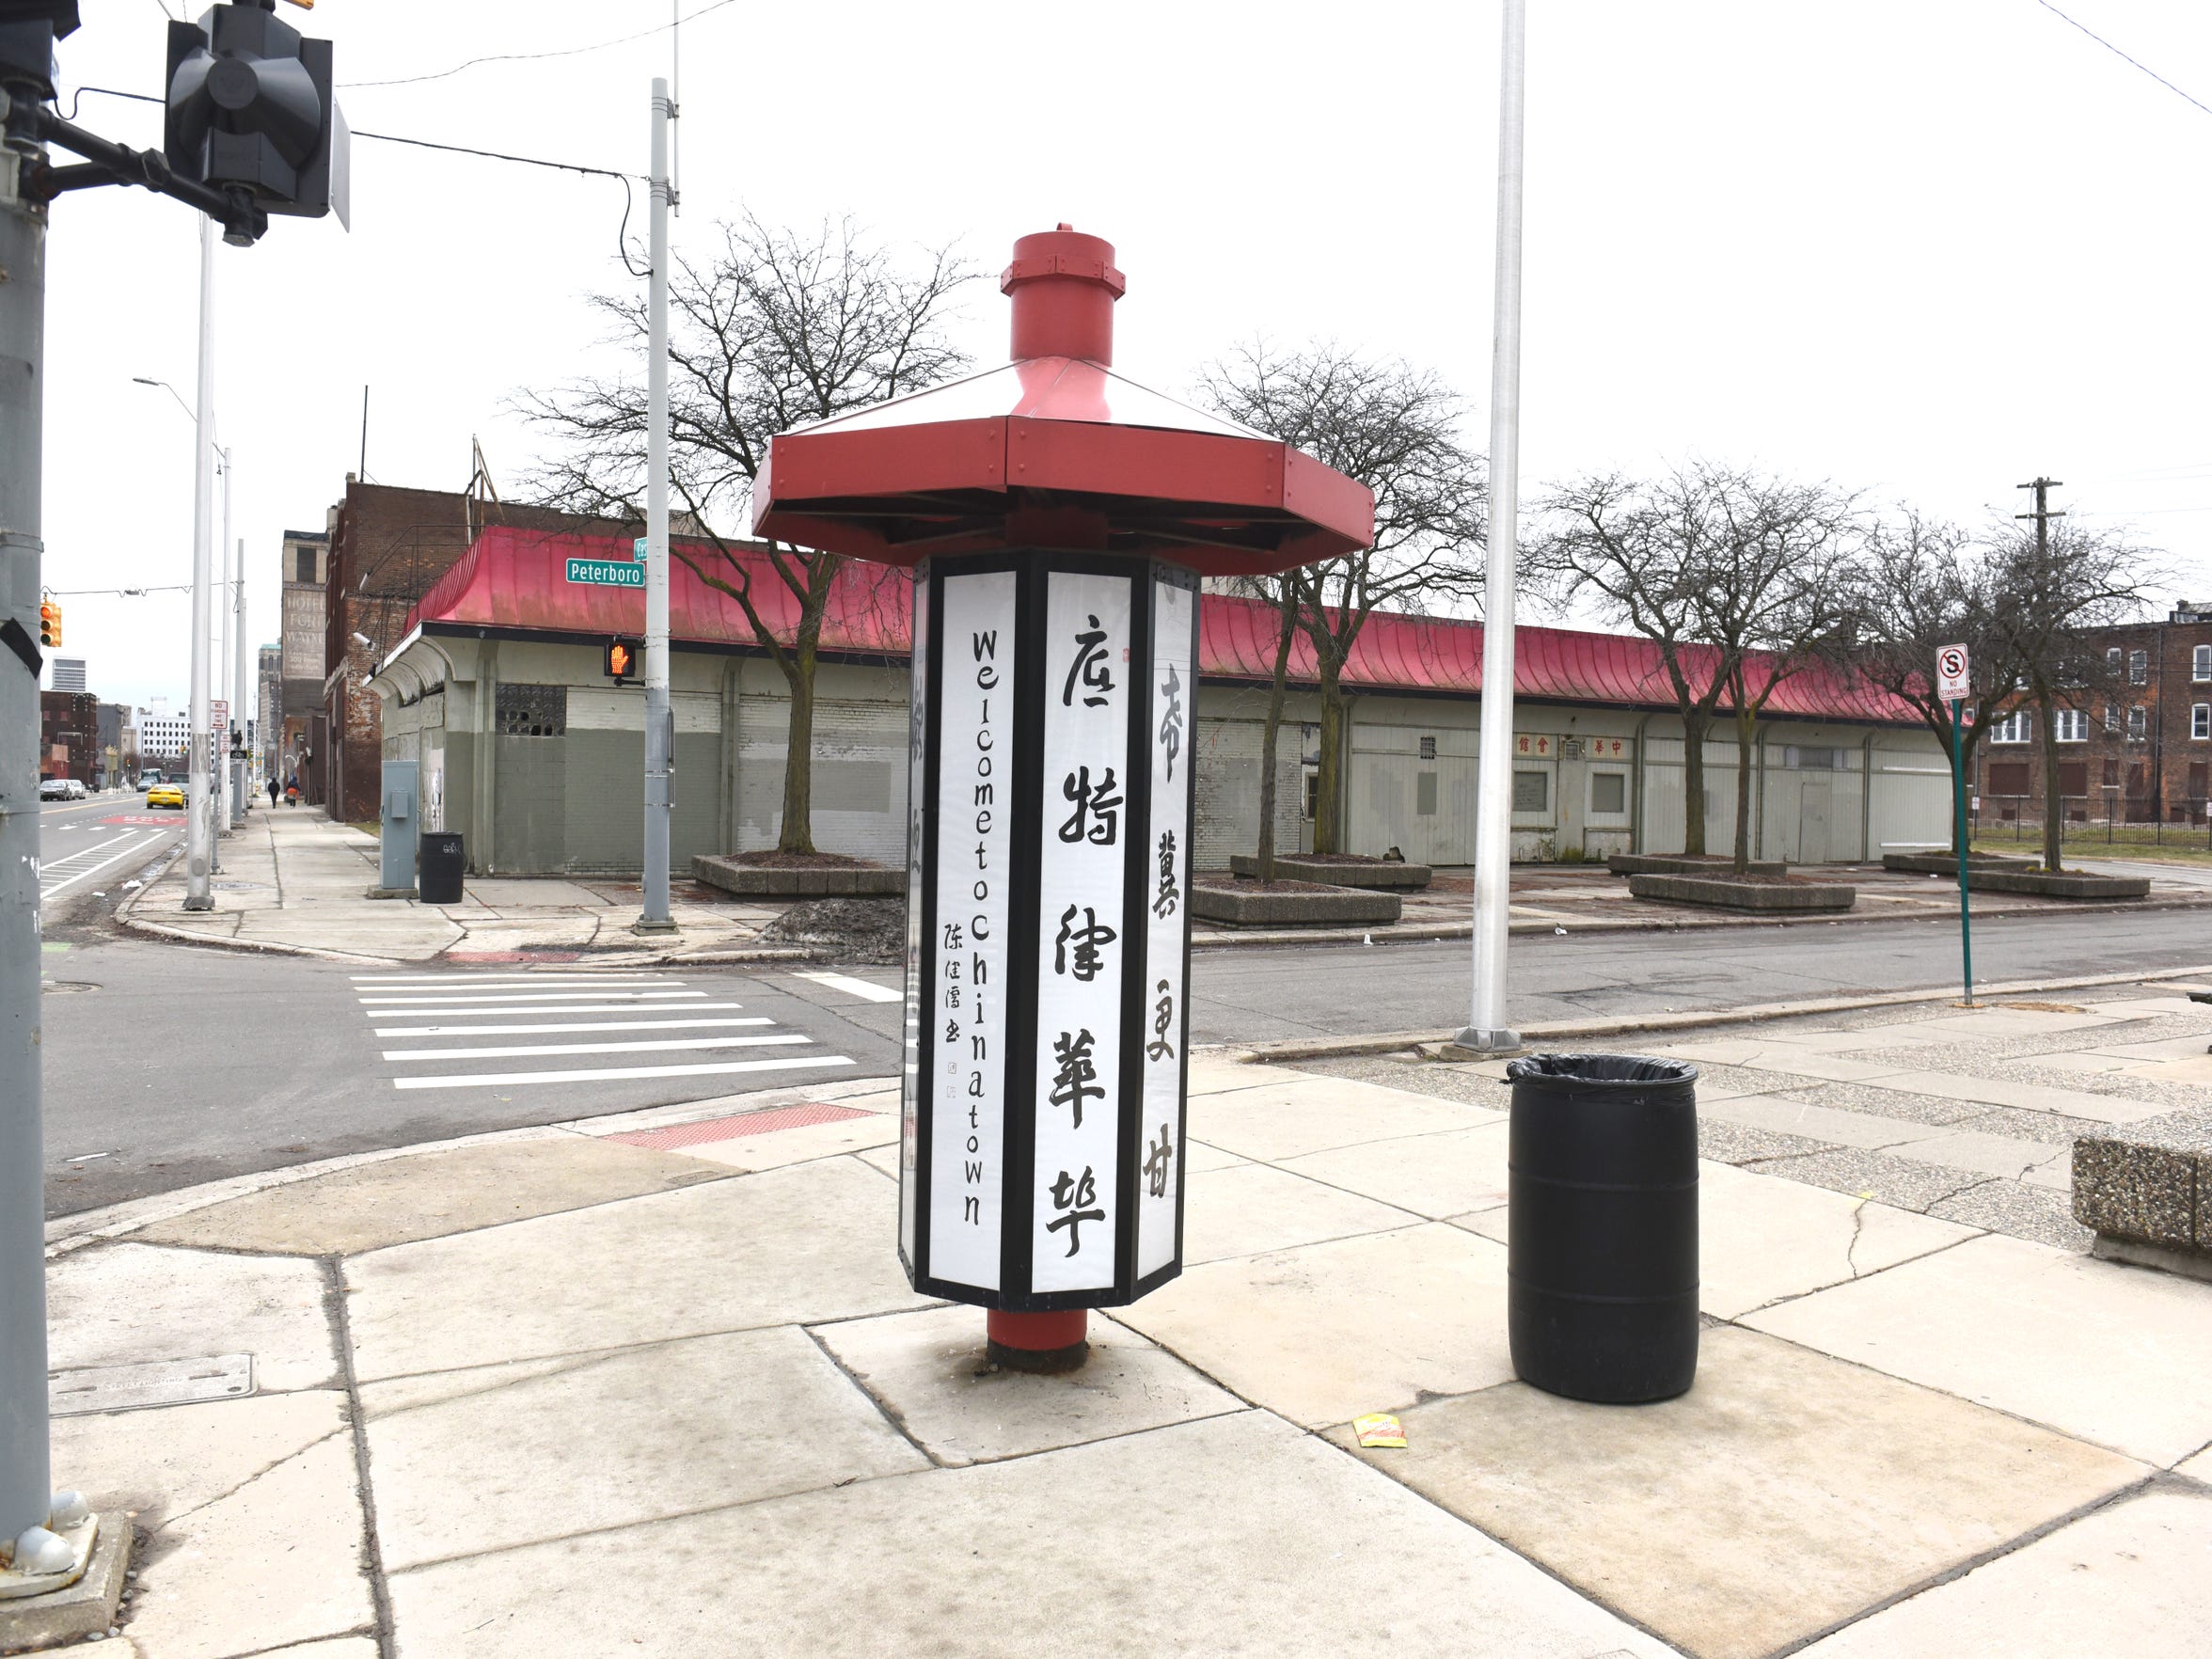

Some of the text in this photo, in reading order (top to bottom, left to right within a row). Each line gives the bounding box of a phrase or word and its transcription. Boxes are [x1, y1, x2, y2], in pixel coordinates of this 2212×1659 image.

[571, 563, 640, 582] Peterboro
[287, 596, 324, 610] HOTEL
[286, 631, 324, 644] WAYNE
[1940, 687, 1967, 696] STANDING
